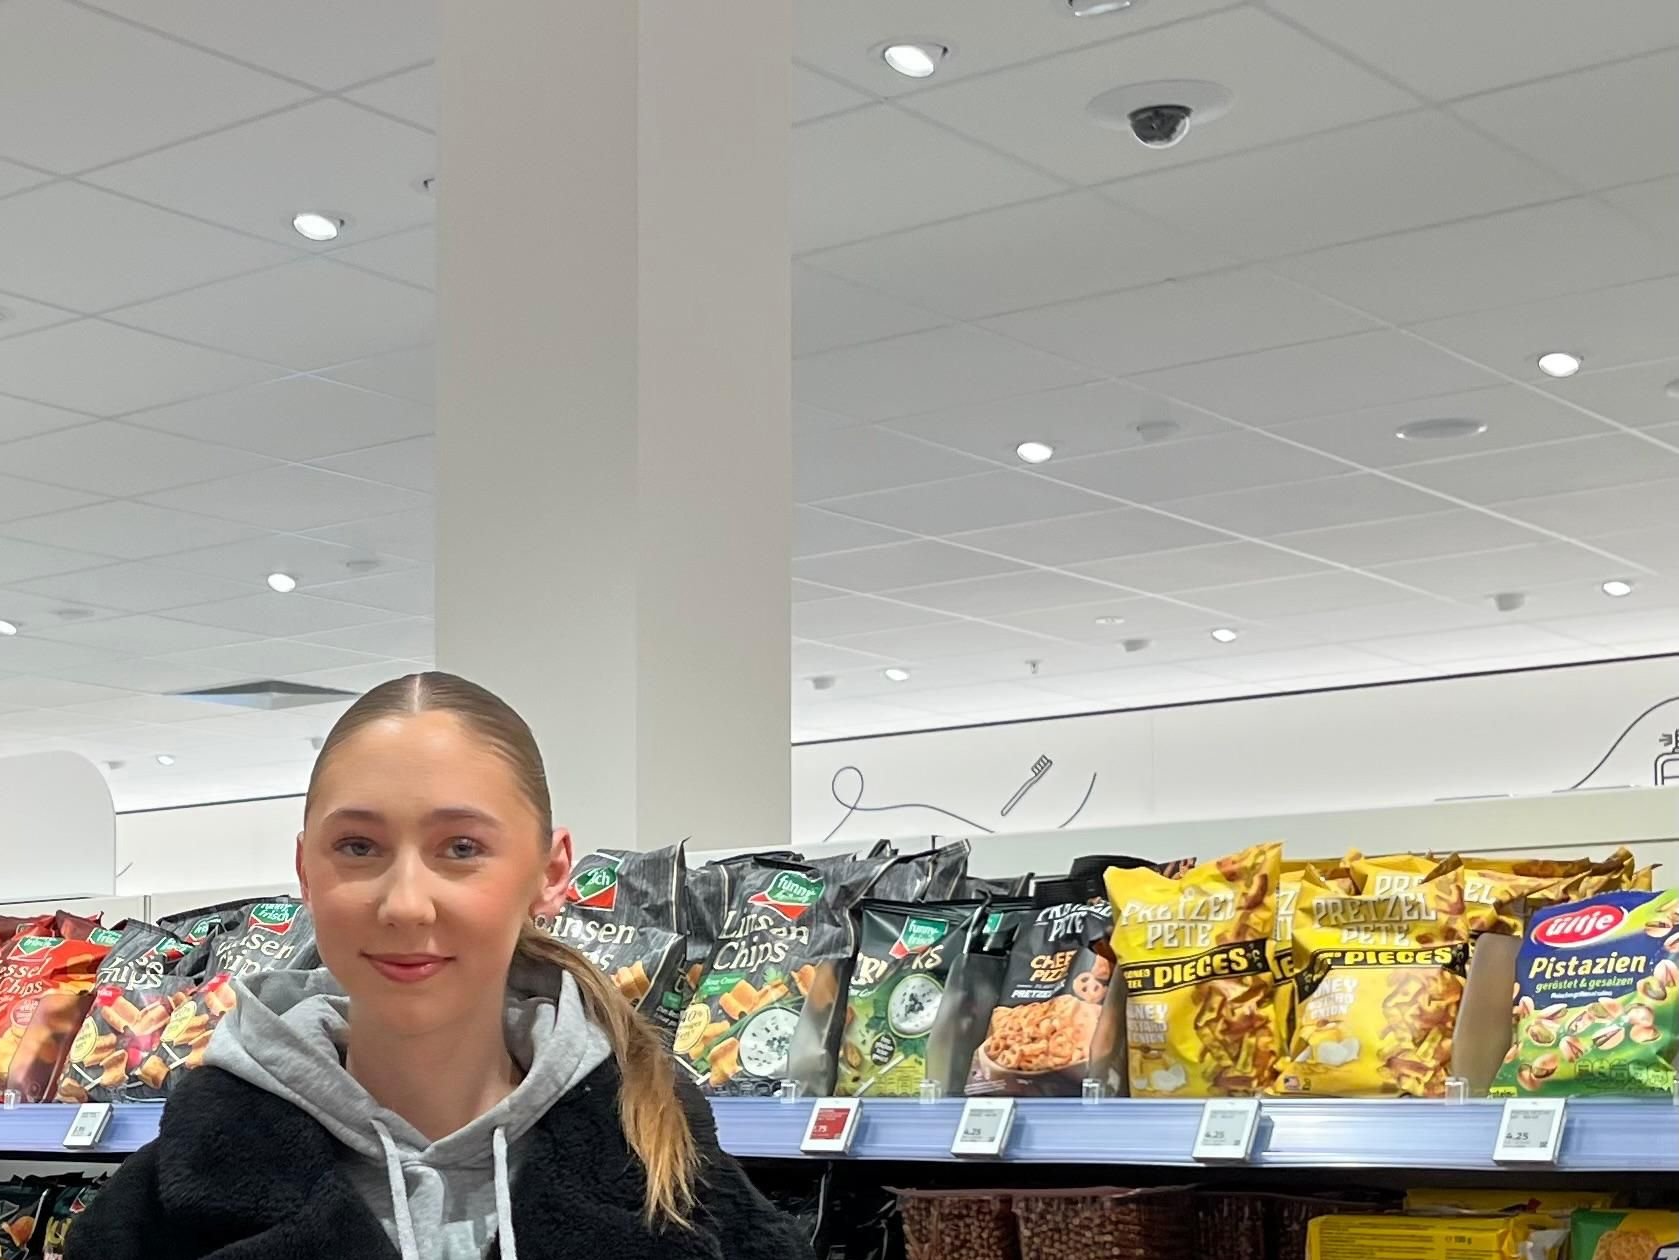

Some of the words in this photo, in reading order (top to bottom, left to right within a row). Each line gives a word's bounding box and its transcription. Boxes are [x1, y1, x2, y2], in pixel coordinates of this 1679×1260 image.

[1311, 891, 1438, 929] PRETZEL
[1147, 921, 1213, 949] PETE
[1340, 922, 1411, 947] PETE
[713, 936, 789, 973] Chips
[1153, 948, 1252, 988] PIECES
[1344, 946, 1452, 966] PIECES
[1528, 952, 1647, 980] Pistazien
[1535, 977, 1578, 993] geröstet
[1580, 978, 1588, 988] &
[1588, 976, 1634, 992] gesalzen
[1505, 1132, 1529, 1141] 4.25
